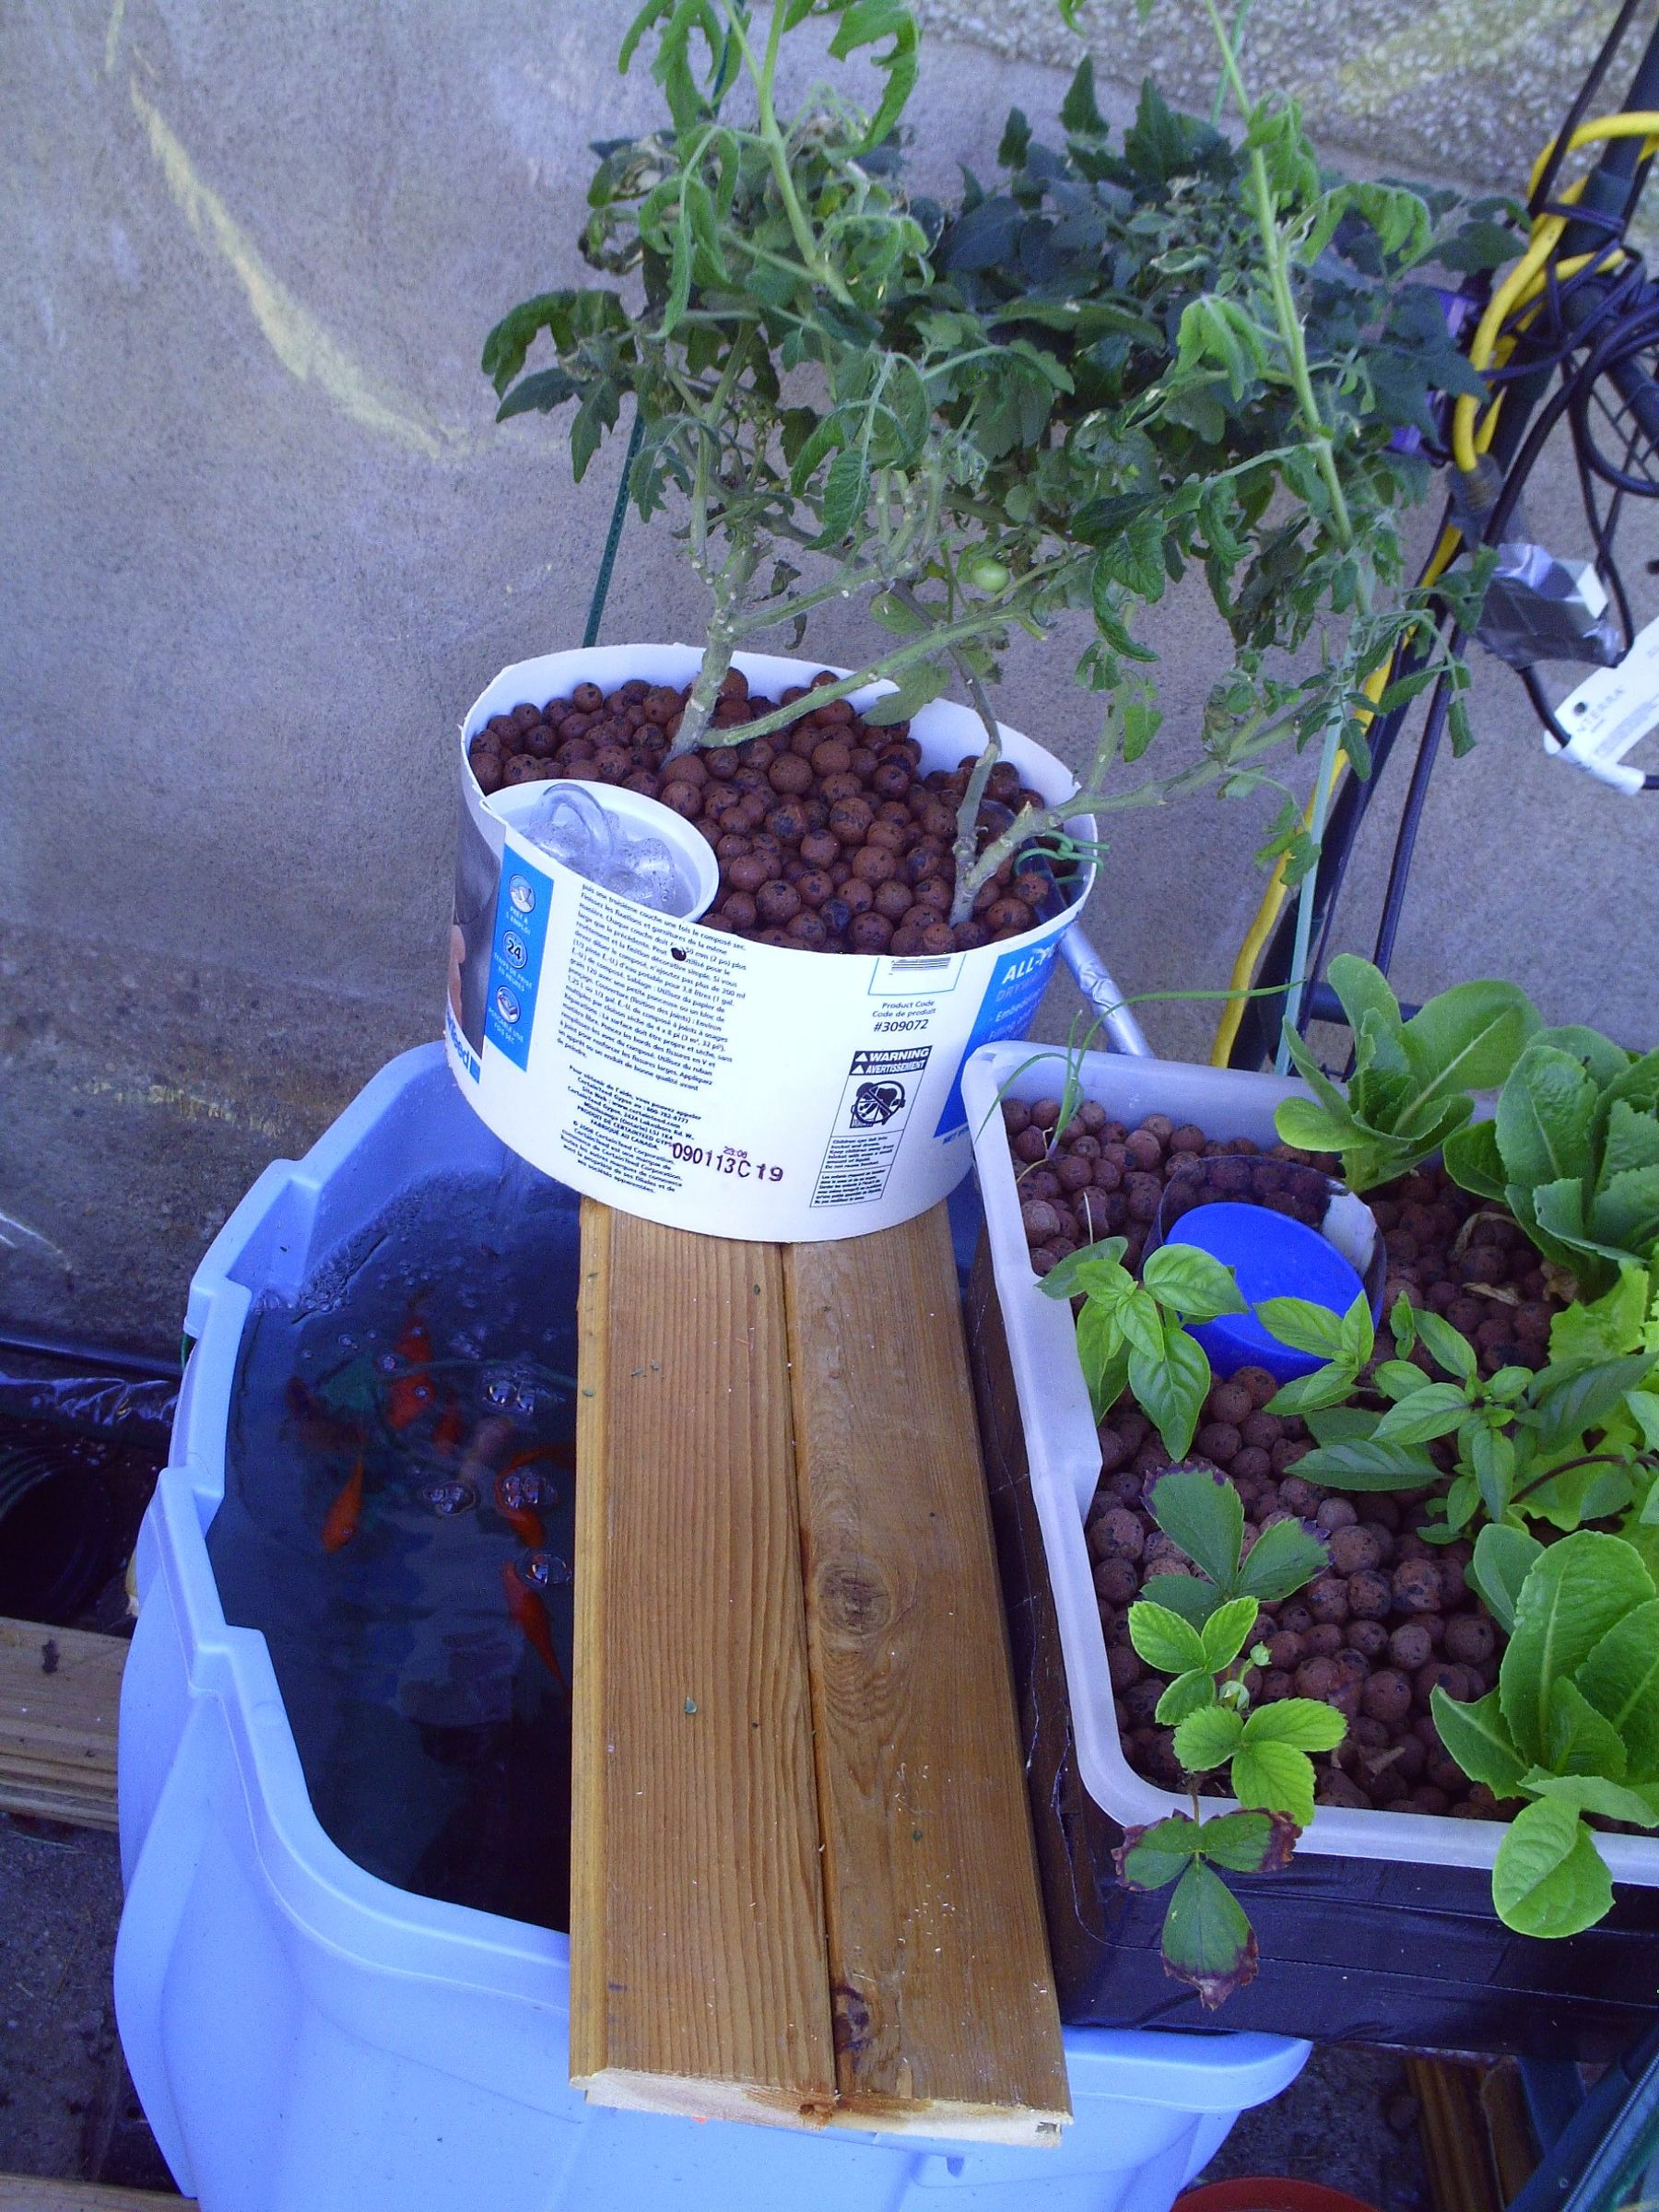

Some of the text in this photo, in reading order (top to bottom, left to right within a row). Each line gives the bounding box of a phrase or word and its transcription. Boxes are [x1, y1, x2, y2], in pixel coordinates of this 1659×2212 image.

[508, 939, 522, 959] 24
[907, 1008, 936, 1018] produit
[873, 1019, 929, 1032] #309072
[869, 1048, 930, 1063] WARNING
[865, 1060, 926, 1075] AVERTISSEMENT
[673, 1143, 783, 1182] 090113C 19
